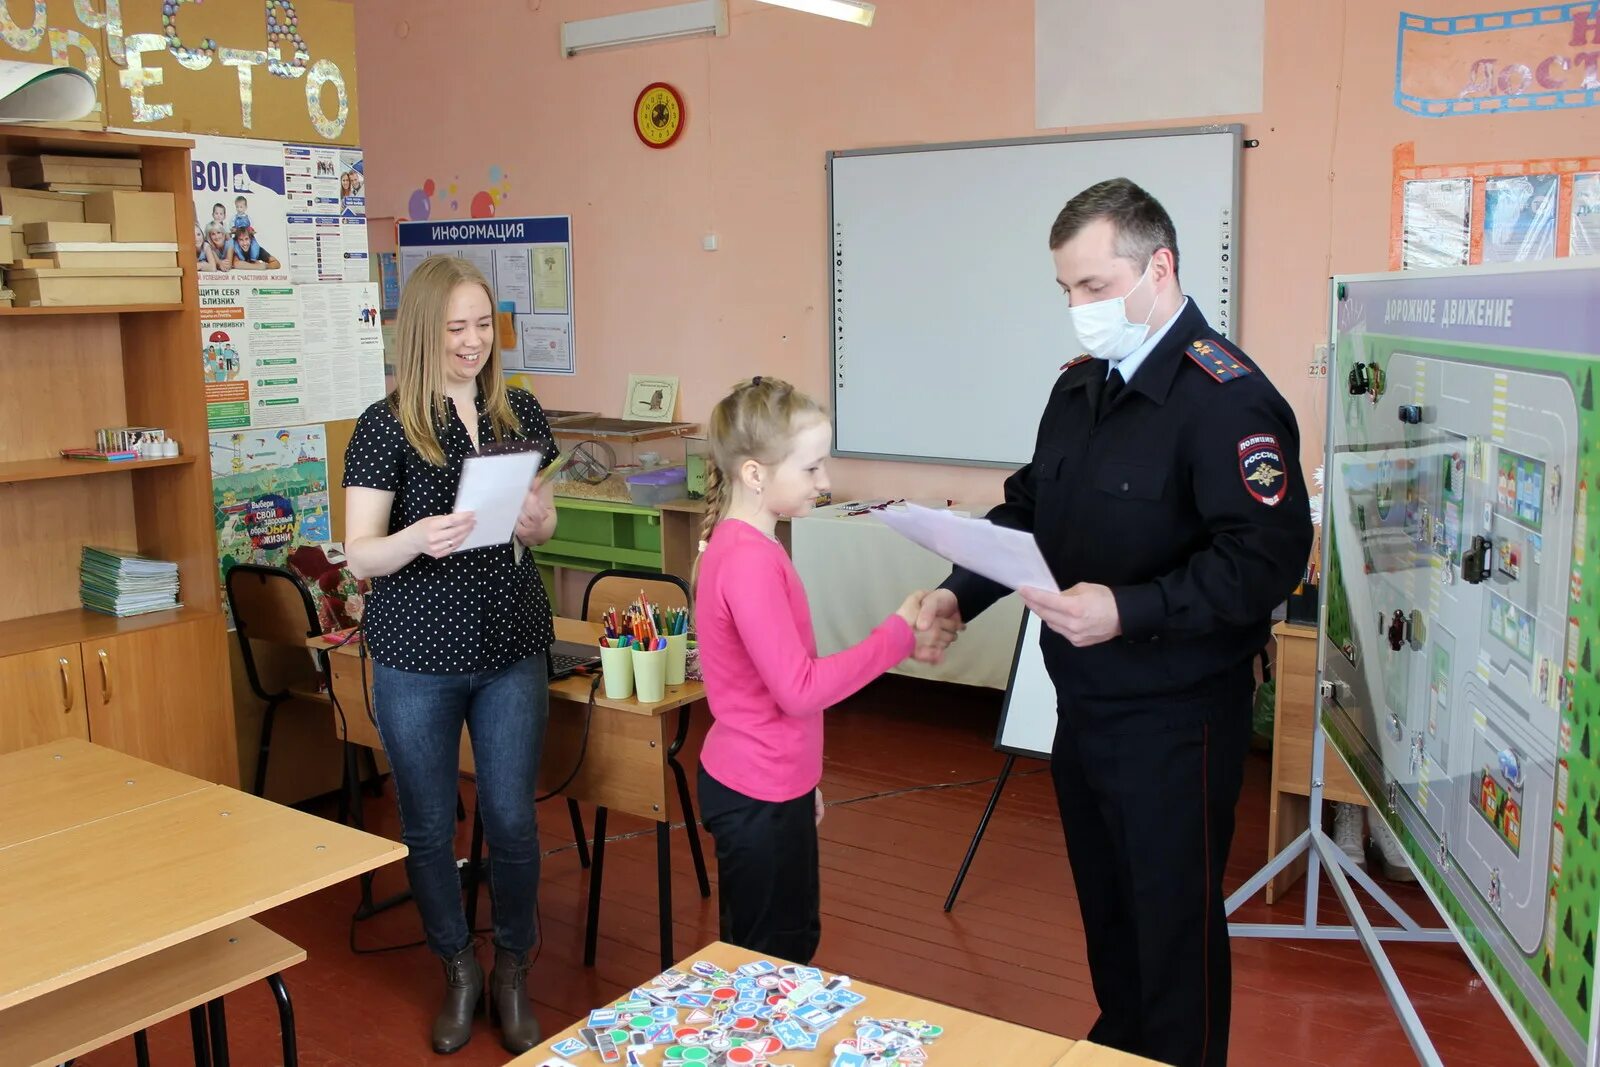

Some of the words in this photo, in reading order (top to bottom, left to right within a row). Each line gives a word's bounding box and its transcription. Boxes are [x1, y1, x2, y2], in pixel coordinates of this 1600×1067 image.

[432, 223, 525, 242] ИНФОРМАЦИЯ
[1384, 299, 1436, 324] ДОРОЖНОЕ
[1442, 298, 1515, 328] ДВИЖЕНИЕ
[1240, 436, 1275, 451] ПОЛИЦИЯ
[1244, 451, 1279, 468] РОССИЯ
[251, 500, 274, 509] Выбери
[256, 509, 276, 520] СВОЙ
[263, 533, 291, 545] ЖИЗНИ
